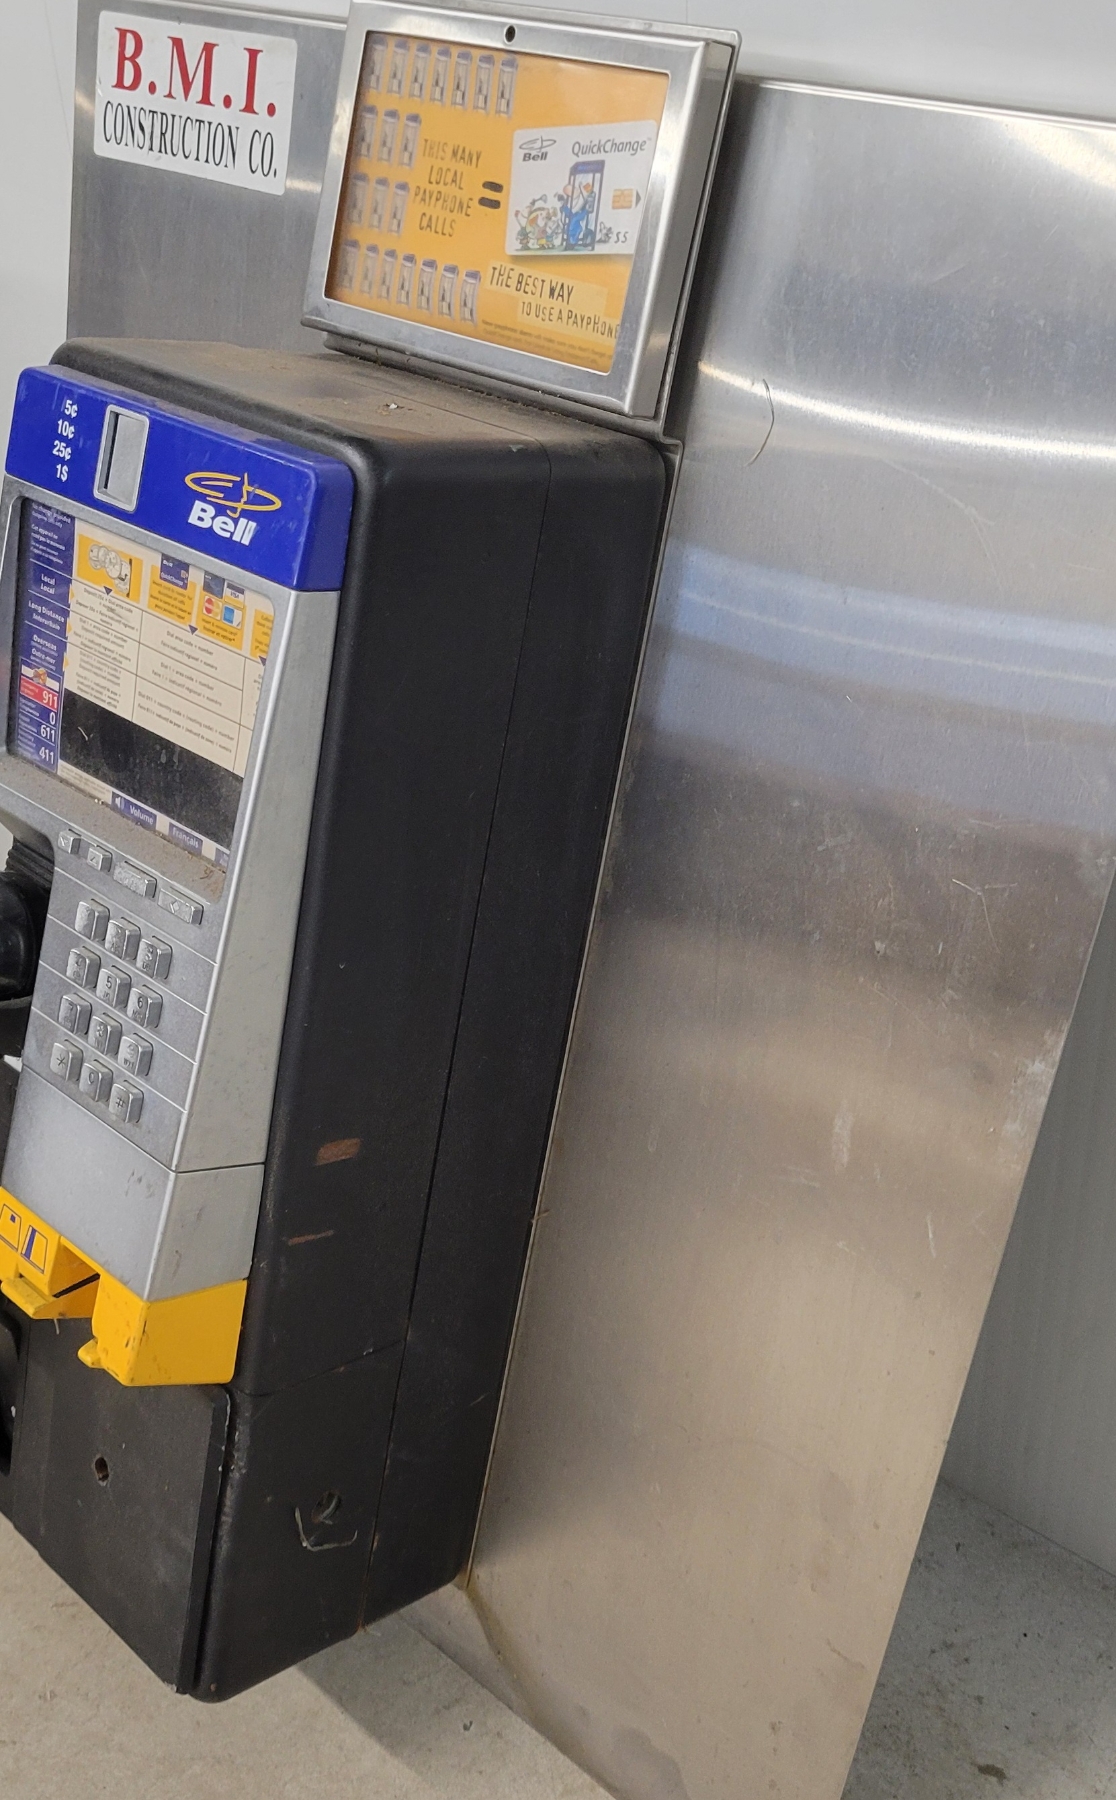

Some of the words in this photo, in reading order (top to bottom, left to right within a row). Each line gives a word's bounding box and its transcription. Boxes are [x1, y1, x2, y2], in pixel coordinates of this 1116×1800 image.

[111, 27, 277, 118] B.M.I.
[103, 100, 240, 170] CONSTRUCTION
[249, 129, 277, 178] CO.
[571, 138, 647, 158] QuickChange
[422, 138, 448, 162] THIS
[451, 144, 482, 168] MANY
[522, 151, 548, 162] Bell
[428, 165, 464, 191] LOCAL
[413, 185, 473, 217] PAYPHONE
[418, 212, 456, 238] CALLS
[489, 264, 515, 289] THE
[515, 272, 546, 299] BEST
[549, 278, 574, 306] WAY
[521, 301, 532, 317] TO
[534, 305, 554, 323] USE
[556, 308, 563, 322] A
[64, 399, 78, 418] 5¢
[57, 418, 75, 440] 10¢
[52, 440, 72, 461] 25¢
[56, 463, 68, 482] 1$
[188, 500, 257, 546] Bell
[40, 583, 55, 594] Local
[41, 574, 55, 585] Local
[28, 600, 41, 613] Long
[42, 607, 64, 622] Distance
[33, 634, 57, 651] Overseas
[42, 690, 58, 708] 911
[50, 712, 56, 725] 0
[40, 724, 55, 742] 611
[39, 746, 54, 764] 411
[129, 805, 153, 825] Volume
[172, 826, 199, 849] Français
[106, 976, 112, 989] 5
[137, 996, 143, 1009] 6
